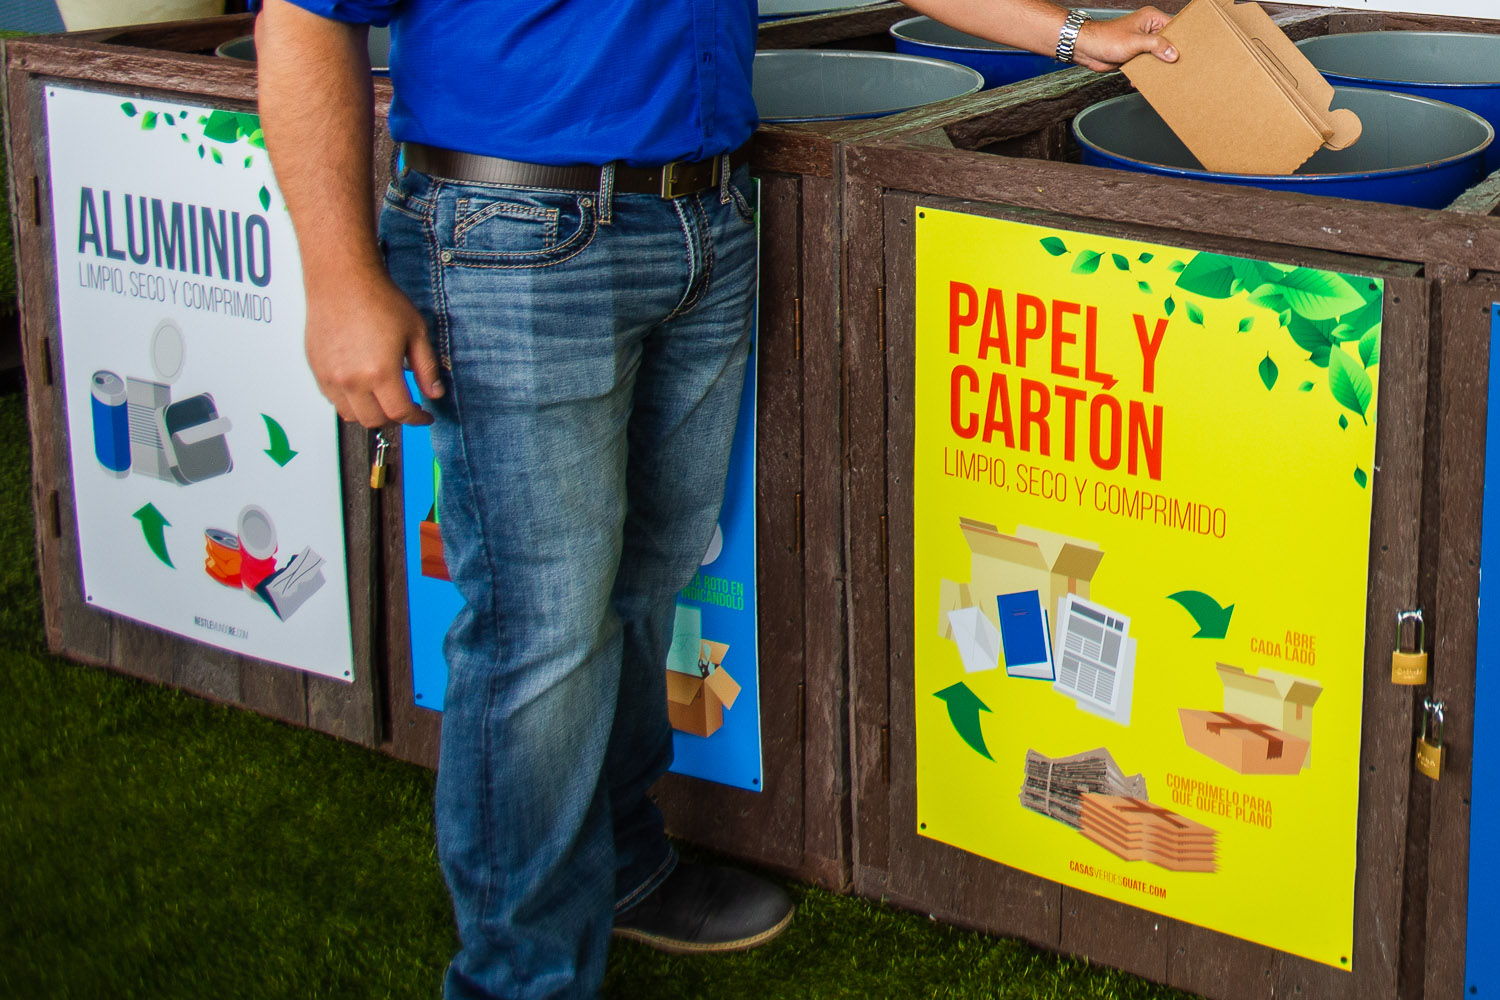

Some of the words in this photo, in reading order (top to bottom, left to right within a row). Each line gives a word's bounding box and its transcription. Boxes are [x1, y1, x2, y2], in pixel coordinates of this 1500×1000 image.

[78, 186, 272, 287] ALUMINIO
[78, 262, 127, 296] LIMPIO,
[129, 271, 166, 303] SECO
[168, 279, 179, 305] Y
[183, 281, 273, 323] COMPRIMIDO
[948, 281, 1112, 384] PAPEL
[1132, 313, 1170, 393] Y
[950, 364, 1164, 481] CARTÓN
[944, 447, 1011, 492] LIMPIO,
[1016, 464, 1067, 499] SECO
[1074, 479, 1088, 506] Y
[1094, 481, 1227, 539] COMPRIMIDO
[704, 575, 728, 593] ROTO
[730, 580, 744, 597] EN
[1250, 637, 1281, 658] CADA
[1285, 645, 1316, 666] LADO
[1285, 630, 1316, 651] ABRE
[1172, 788, 1193, 808] QUE
[1196, 795, 1232, 818] QUEDE
[1236, 806, 1273, 830] PLANO
[1243, 794, 1272, 815] PARA
[1069, 860, 1167, 899] CASASVERDESGUATE.COM
